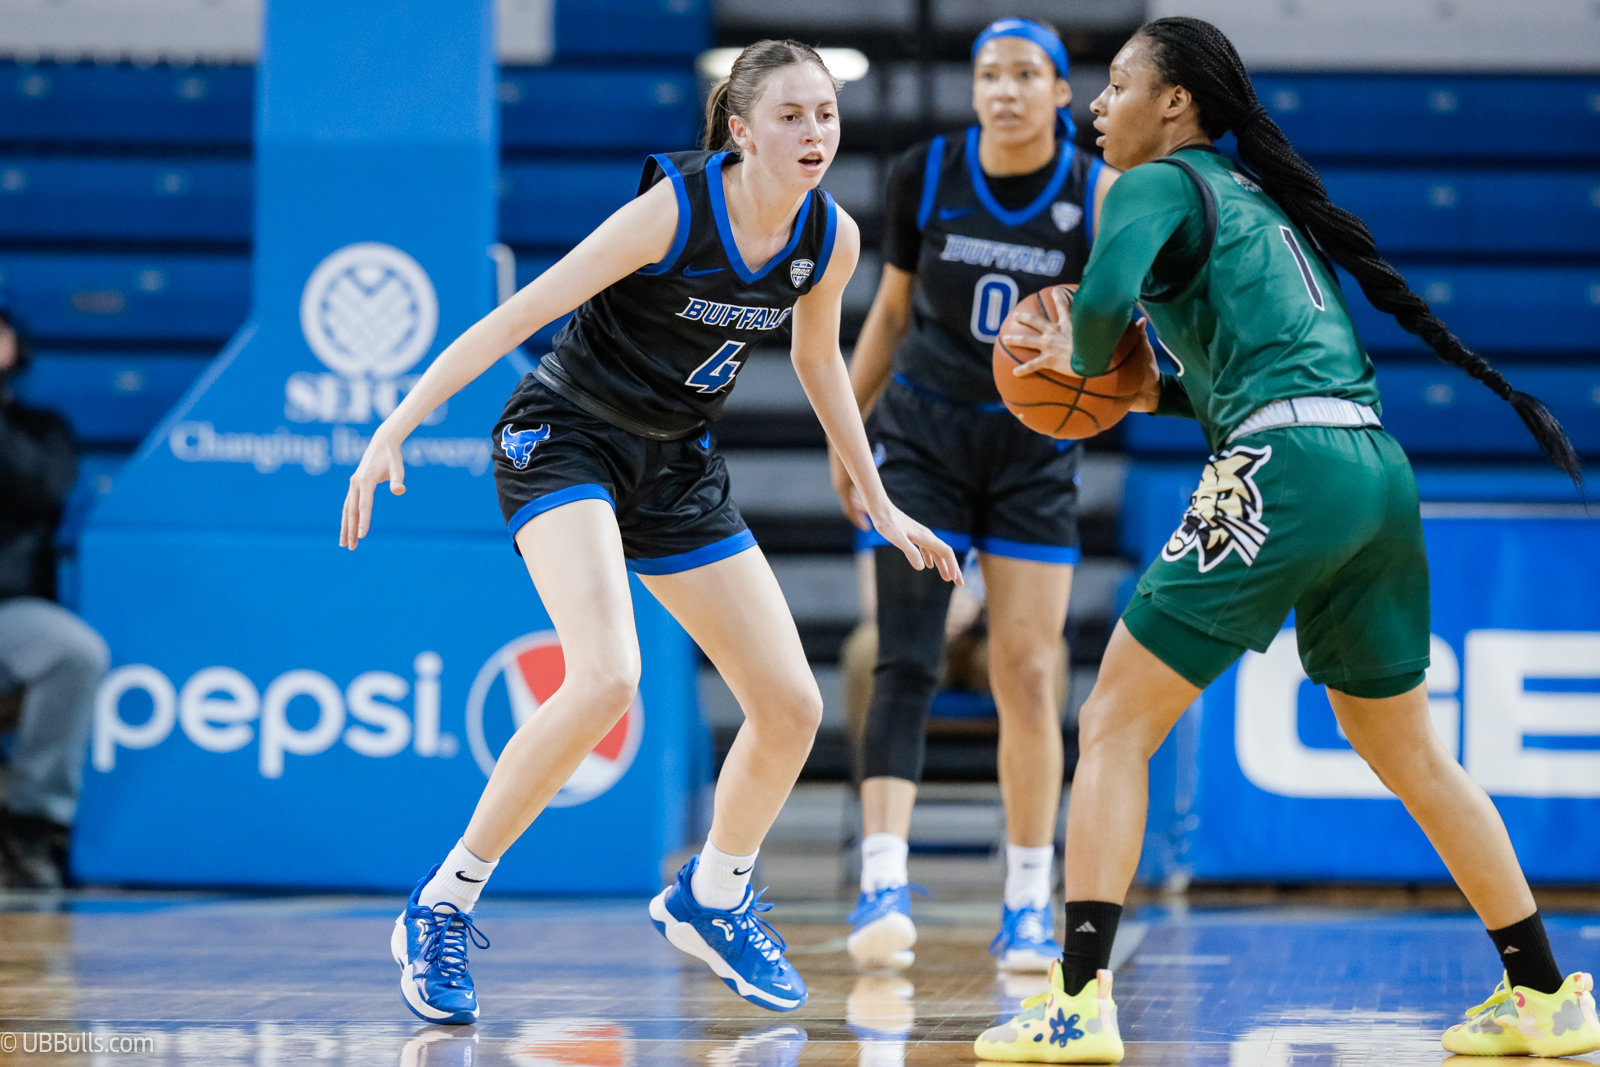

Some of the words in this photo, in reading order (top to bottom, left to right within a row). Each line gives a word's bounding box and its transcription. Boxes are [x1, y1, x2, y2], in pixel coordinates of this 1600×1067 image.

[939, 233, 1066, 277] BUFFALO
[1279, 225, 1325, 311] 1
[675, 297, 792, 331] BUFFALO
[970, 273, 1019, 344] 0
[684, 340, 747, 394] 4
[169, 421, 331, 474] Changing
[93, 651, 442, 778] pepsi
